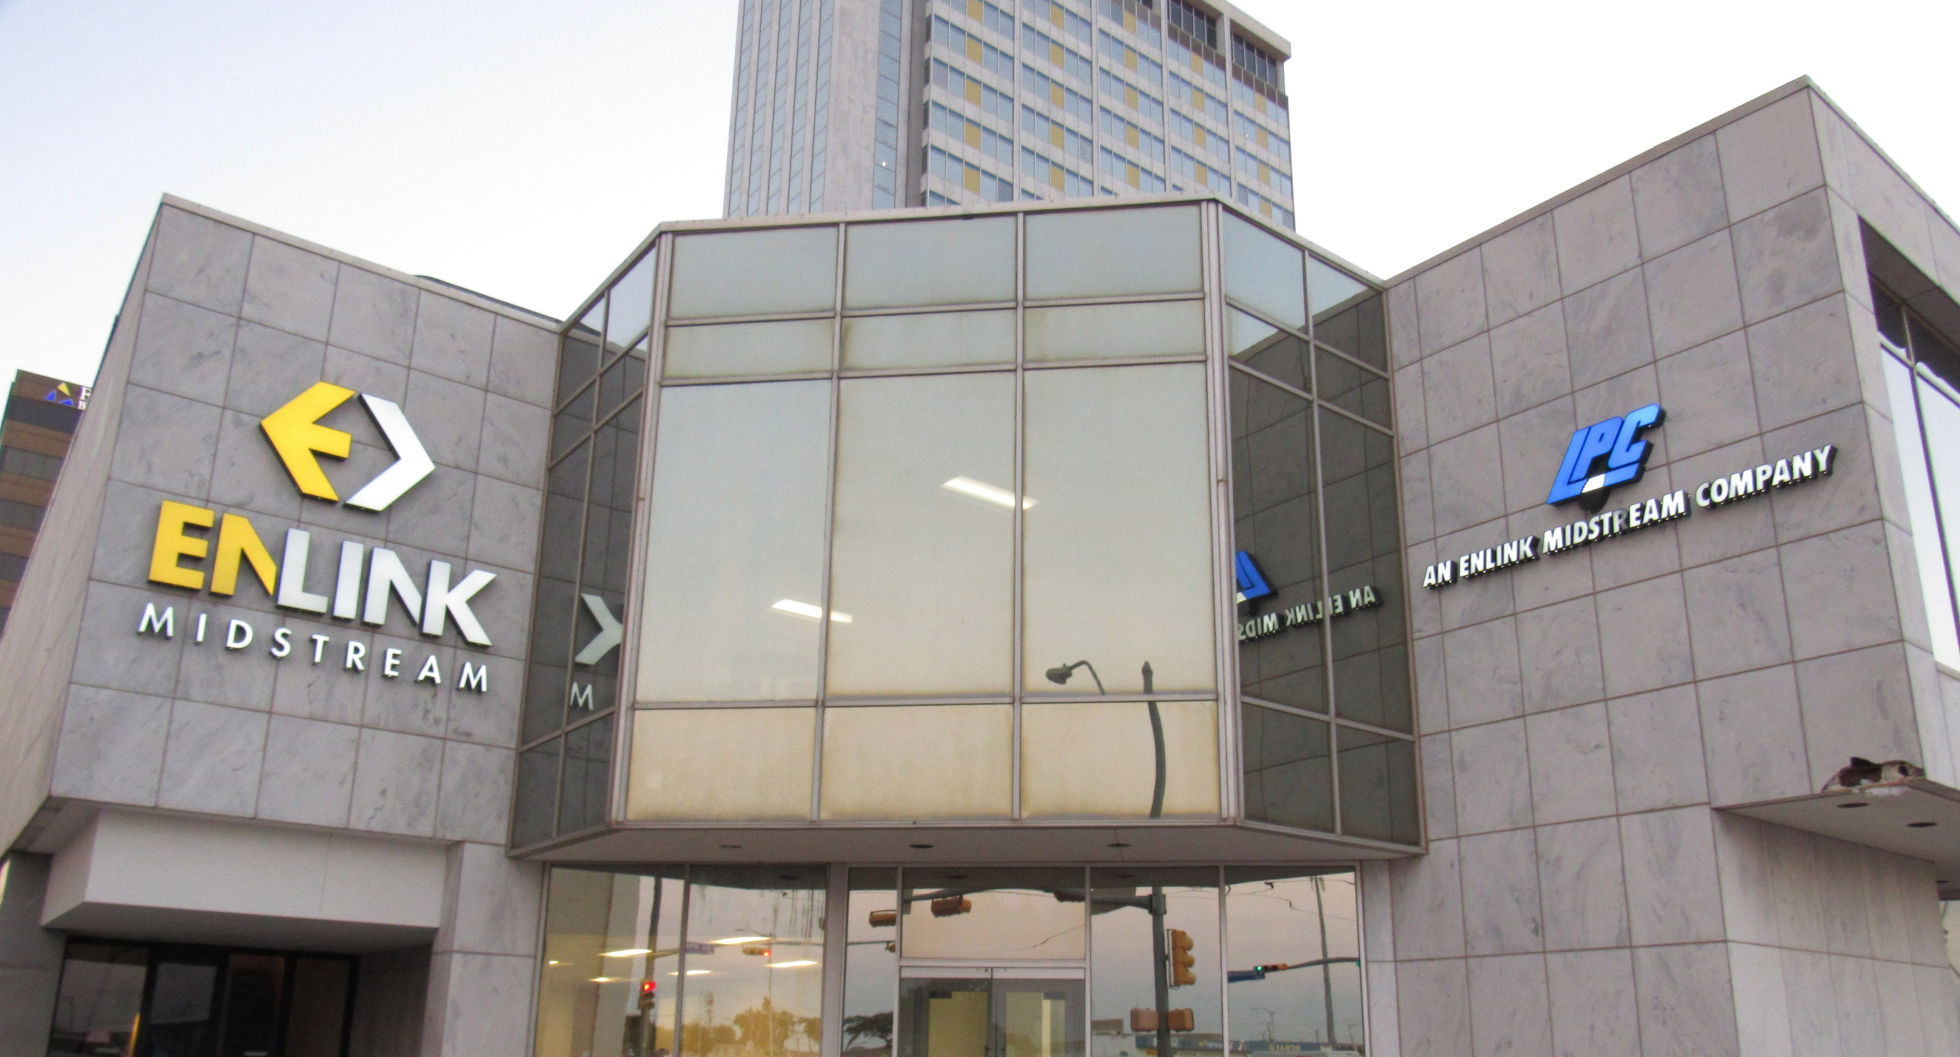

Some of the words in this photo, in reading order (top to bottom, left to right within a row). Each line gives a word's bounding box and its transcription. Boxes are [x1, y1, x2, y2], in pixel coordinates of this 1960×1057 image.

[1546, 402, 1663, 505] LPC
[148, 500, 497, 647] ENLINK
[1423, 560, 1456, 588] AN
[1459, 536, 1537, 578] ENLINK
[1542, 489, 1688, 555] MIDSTREAM
[1695, 444, 1836, 509] COMPANY
[137, 602, 488, 692] MIDSTREAM
